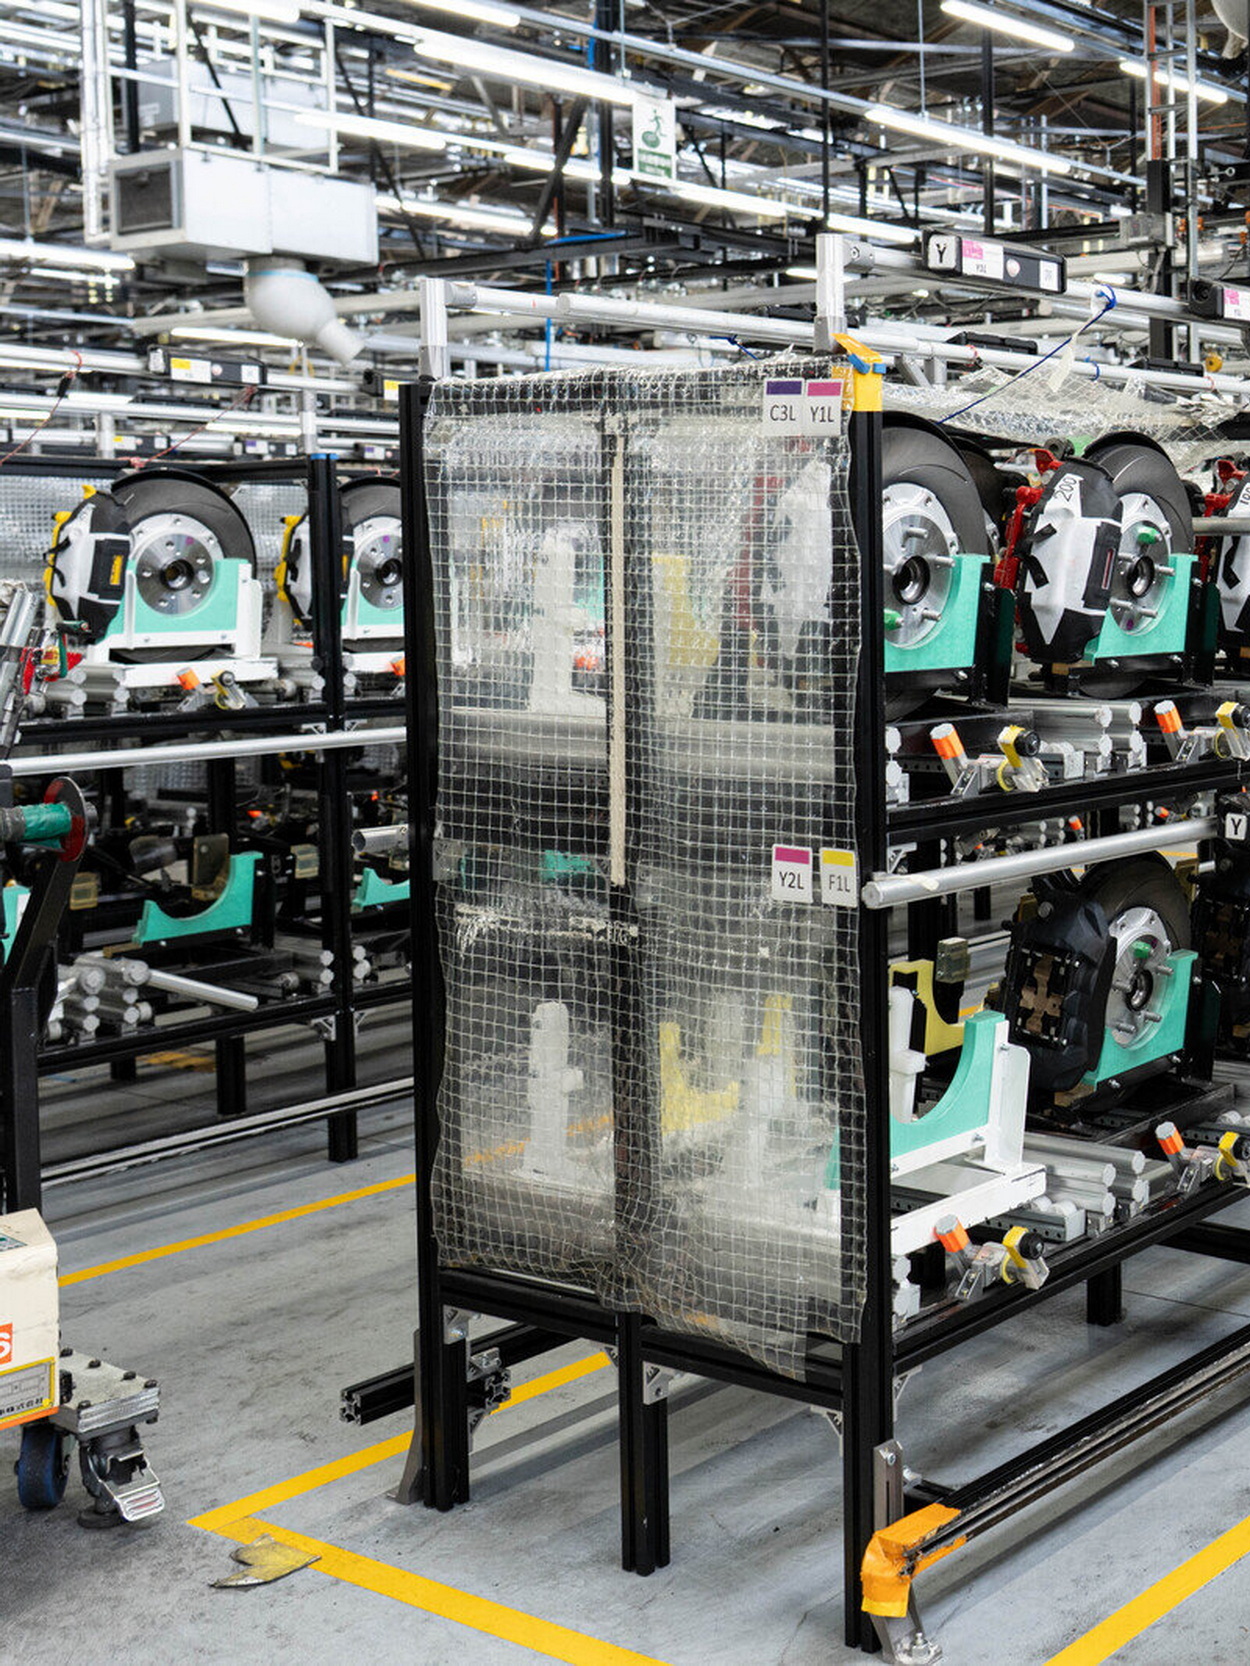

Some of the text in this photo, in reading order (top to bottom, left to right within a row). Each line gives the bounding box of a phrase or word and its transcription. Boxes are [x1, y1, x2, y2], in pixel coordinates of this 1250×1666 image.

[935, 243, 947, 264] Y
[769, 404, 797, 422] C3L
[810, 406, 835, 423] Y1L
[1230, 817, 1242, 836] Y
[779, 871, 805, 890] Y2L
[828, 874, 851, 893] F1L
